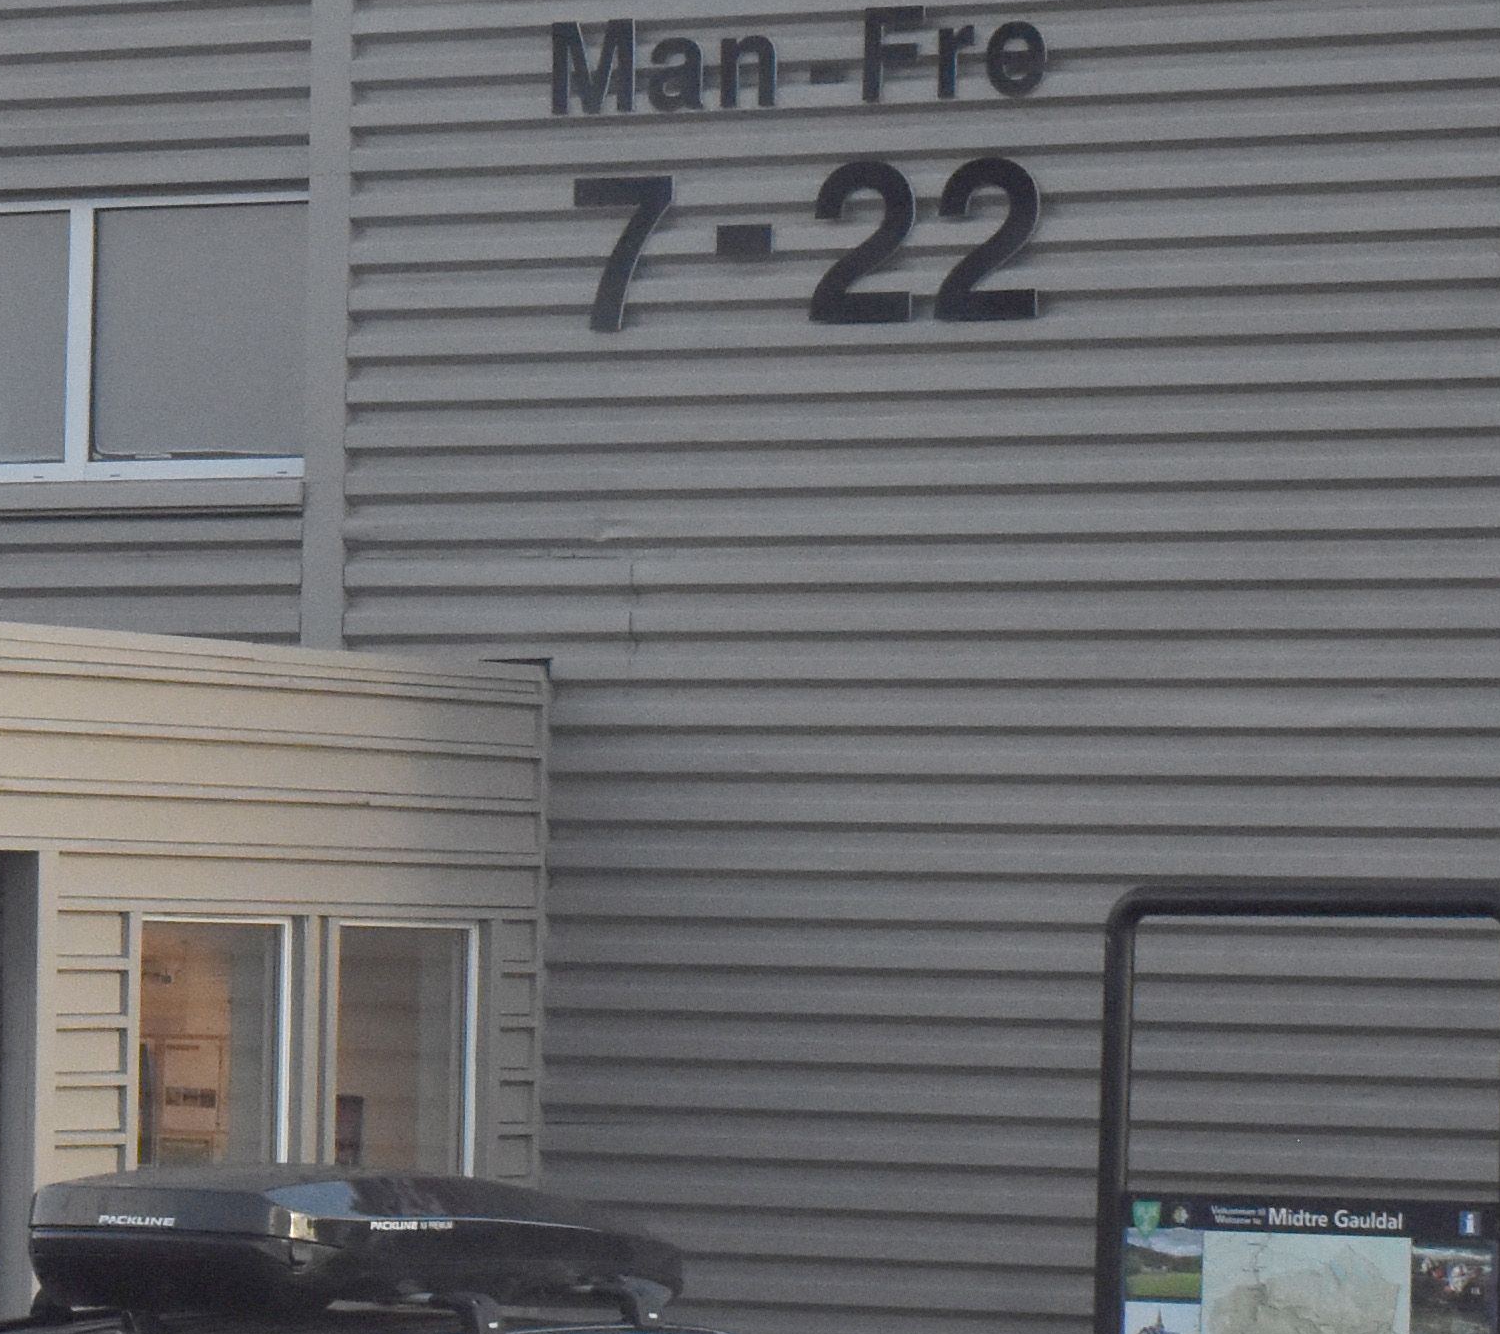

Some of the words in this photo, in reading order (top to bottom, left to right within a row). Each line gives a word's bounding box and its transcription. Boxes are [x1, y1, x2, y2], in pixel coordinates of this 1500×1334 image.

[98, 1214, 175, 1228] PACKLINE
[370, 1220, 418, 1231] PACKLINE
[1268, 1207, 1328, 1228] Midtre
[1334, 1209, 1403, 1230] Gauldal
